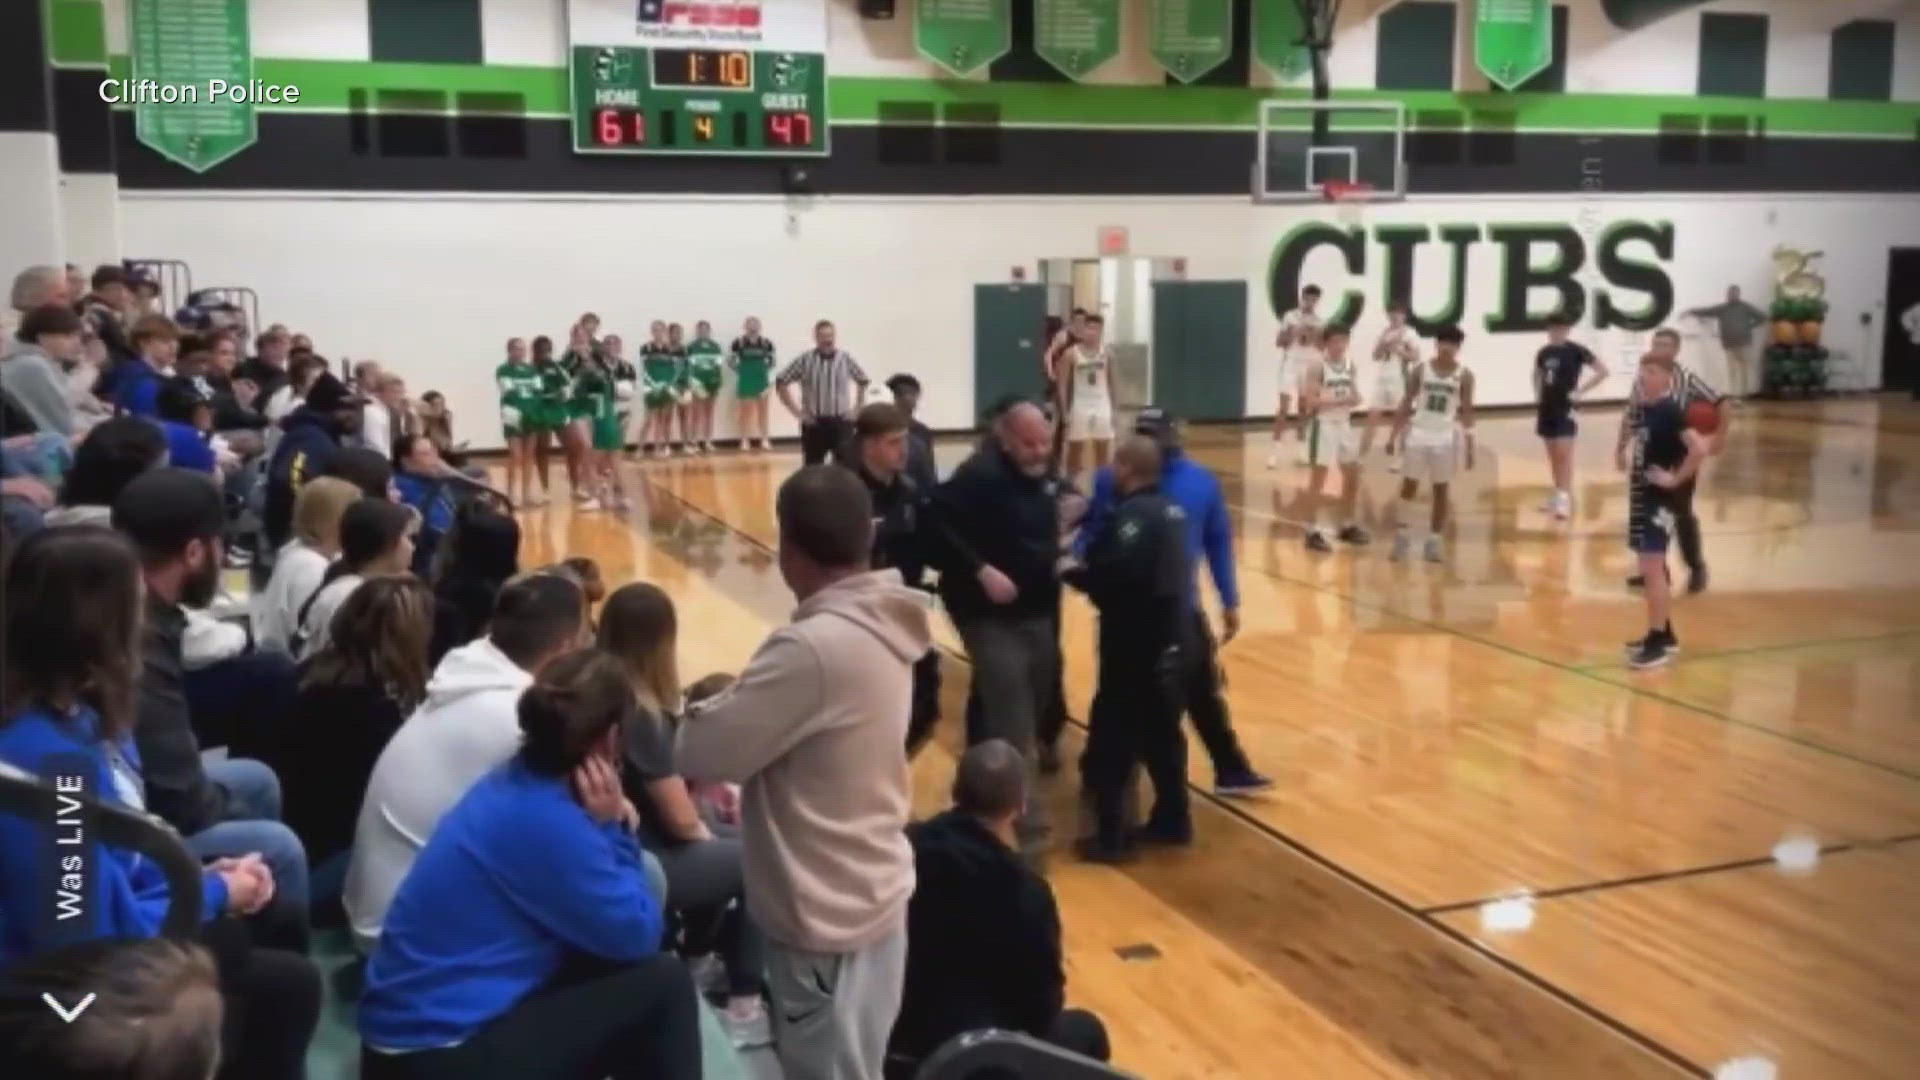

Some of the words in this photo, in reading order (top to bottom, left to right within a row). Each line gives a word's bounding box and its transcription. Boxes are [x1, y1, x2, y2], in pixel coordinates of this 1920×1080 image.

[687, 52, 748, 86] 1:10
[595, 89, 640, 107] HOME
[600, 110, 645, 145] 61
[694, 116, 713, 140] 4
[770, 113, 813, 145] 47
[1267, 220, 1675, 338] CUBS
